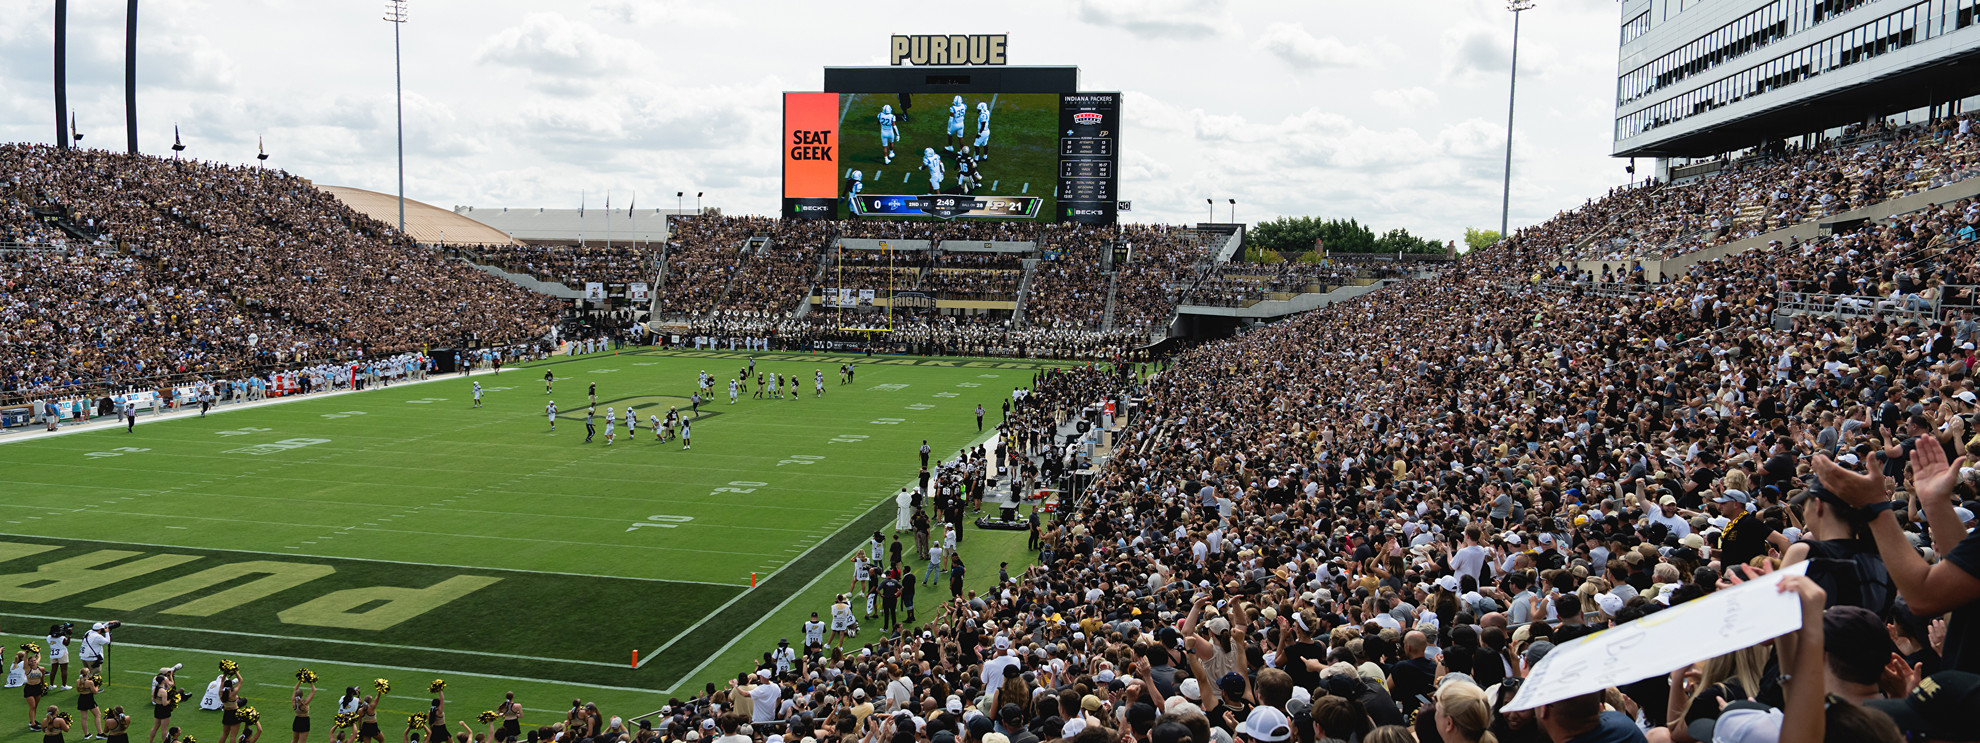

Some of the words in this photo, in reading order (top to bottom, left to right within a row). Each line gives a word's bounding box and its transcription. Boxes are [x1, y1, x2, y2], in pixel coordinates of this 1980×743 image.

[891, 34, 1007, 66] PURDUE
[881, 117, 891, 126] 22
[793, 130, 831, 145] SEAT
[791, 146, 833, 161] GEEK
[959, 162, 969, 173] 16
[873, 200, 882, 209] 0
[1009, 202, 1022, 211] 21
[1119, 201, 1130, 211] 40
[831, 434, 870, 444] 40
[780, 454, 826, 466] 30
[713, 480, 769, 495] 20
[629, 514, 695, 530] 10
[0, 541, 505, 632] PUR
[835, 621, 844, 629] 36
[203, 697, 214, 706] 33
